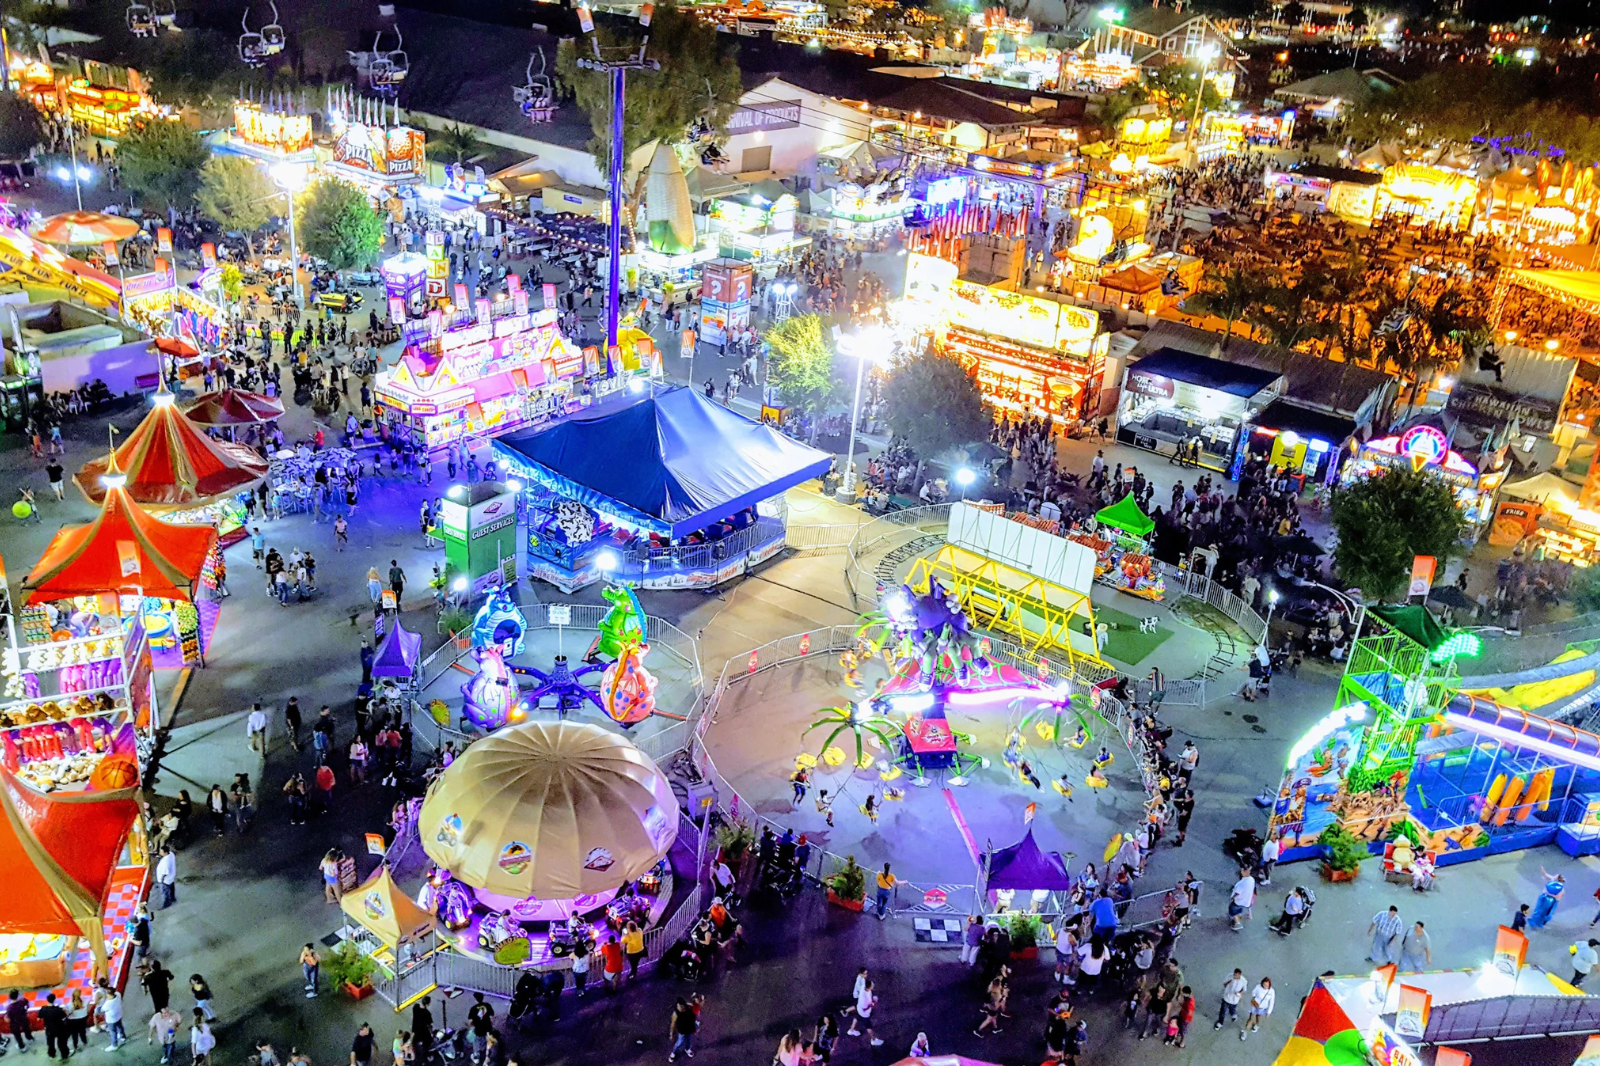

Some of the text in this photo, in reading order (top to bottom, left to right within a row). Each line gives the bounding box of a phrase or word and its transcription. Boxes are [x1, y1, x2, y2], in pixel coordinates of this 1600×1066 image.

[754, 110, 764, 126] OF
[765, 106, 799, 125] PRODUCTS
[345, 142, 374, 168] PIZZA
[389, 160, 412, 173] PIZZA
[3, 253, 24, 266] FUN
[31, 266, 52, 280] FUN
[59, 280, 79, 293] FUN
[1148, 384, 1168, 397] ULTRA
[444, 399, 469, 410] POPCORN
[1451, 399, 1503, 419] CHICKEN
[1475, 395, 1531, 416] HAWAIIAN
[472, 527, 490, 541] GUEST
[490, 517, 515, 533] SERVICES
